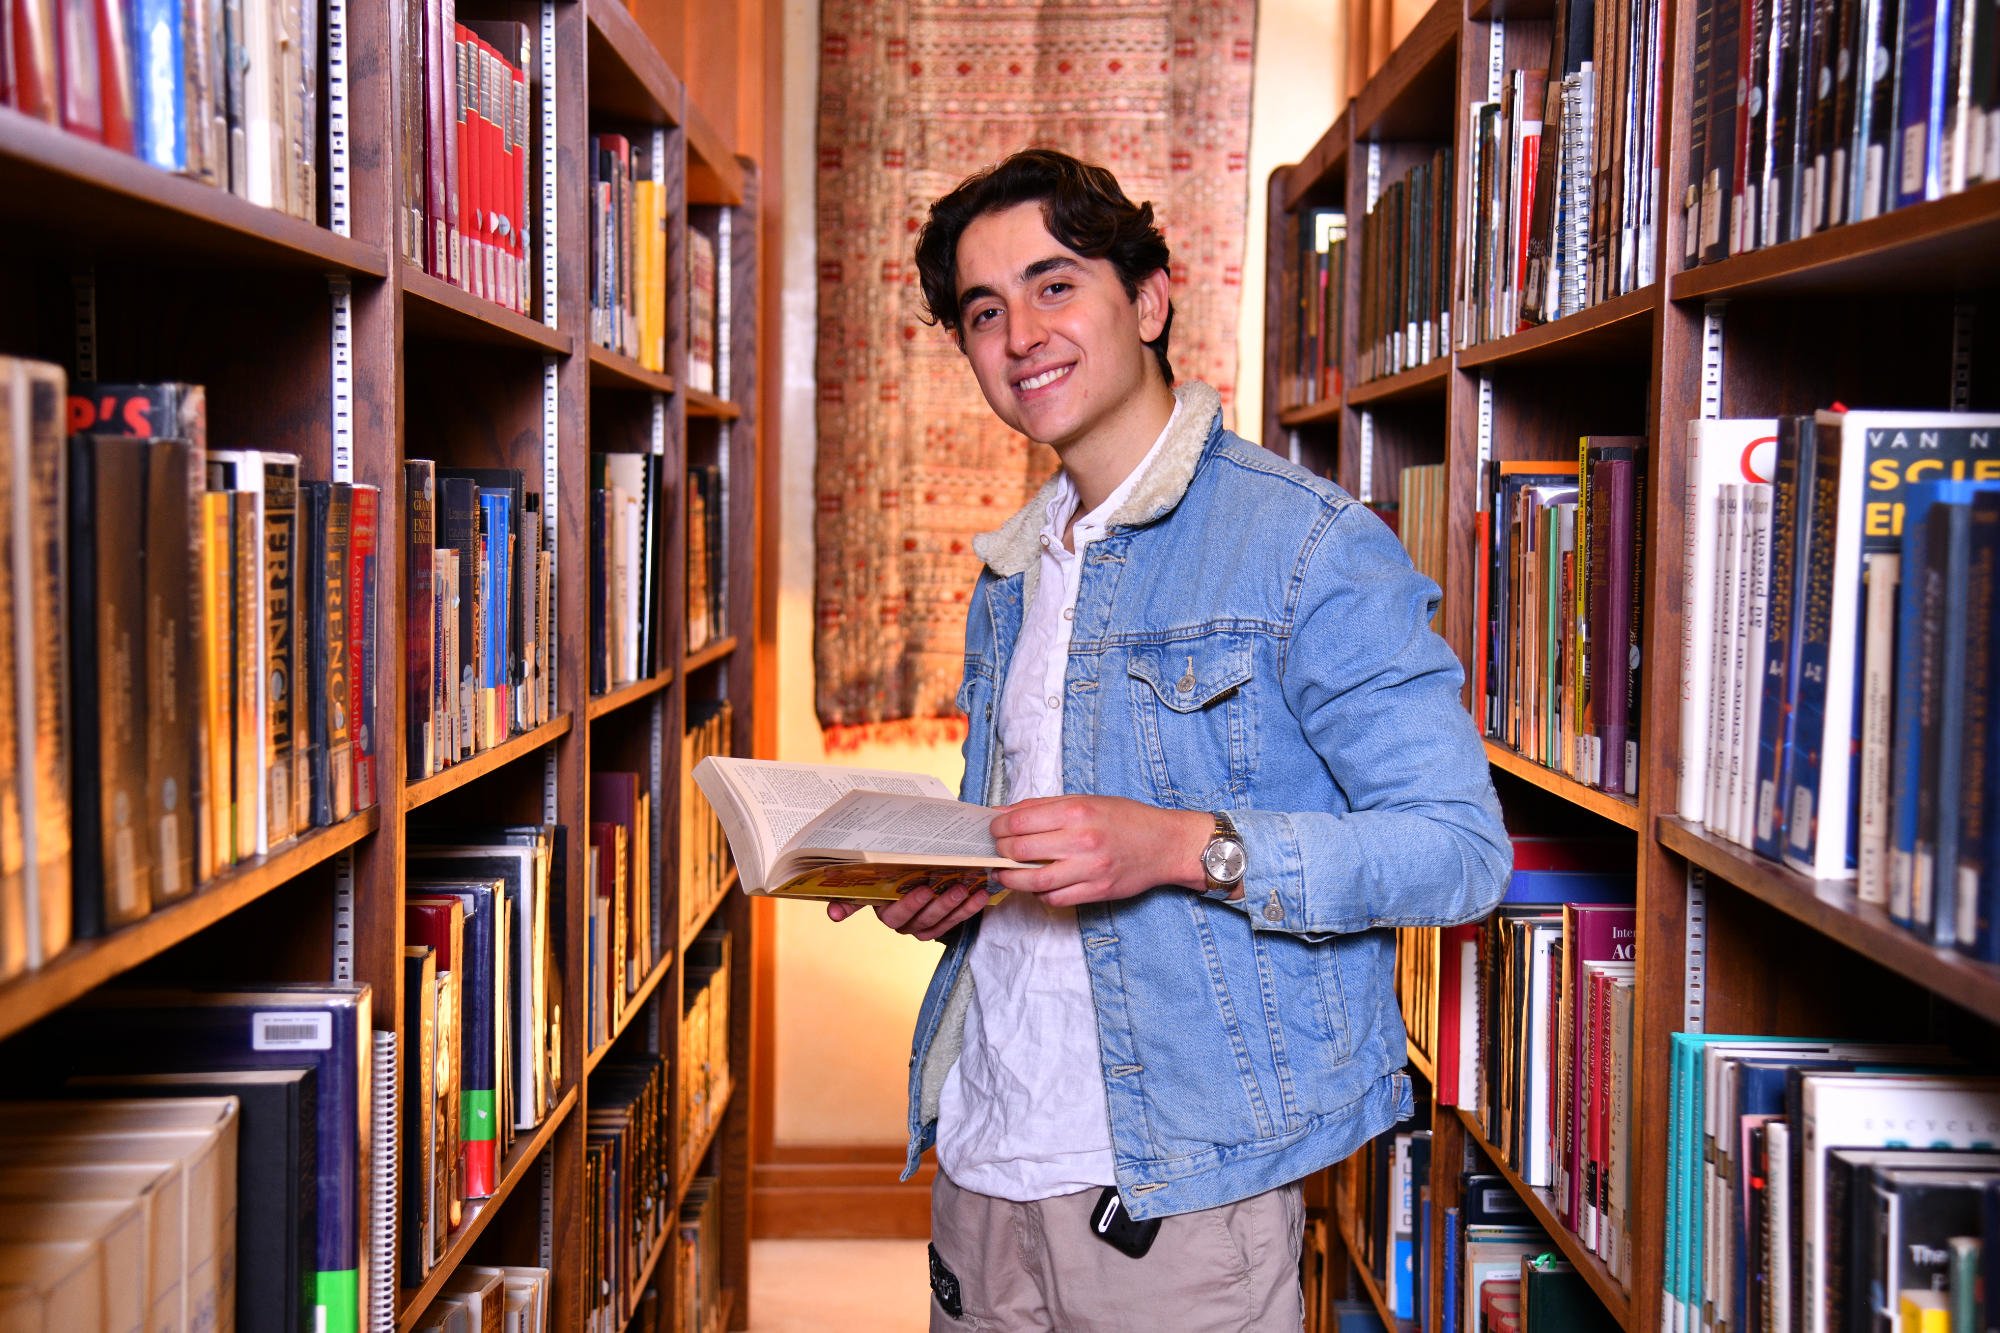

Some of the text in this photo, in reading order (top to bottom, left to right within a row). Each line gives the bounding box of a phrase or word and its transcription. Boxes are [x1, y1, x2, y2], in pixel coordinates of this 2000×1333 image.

[1869, 432, 2000, 449] VAN N
[1635, 474, 1645, 528] Literature
[1634, 530, 1641, 541] of
[1632, 543, 1641, 597] Developing
[267, 520, 289, 741] FRENCH
[1566, 1056, 1574, 1154] DIRECTORS
